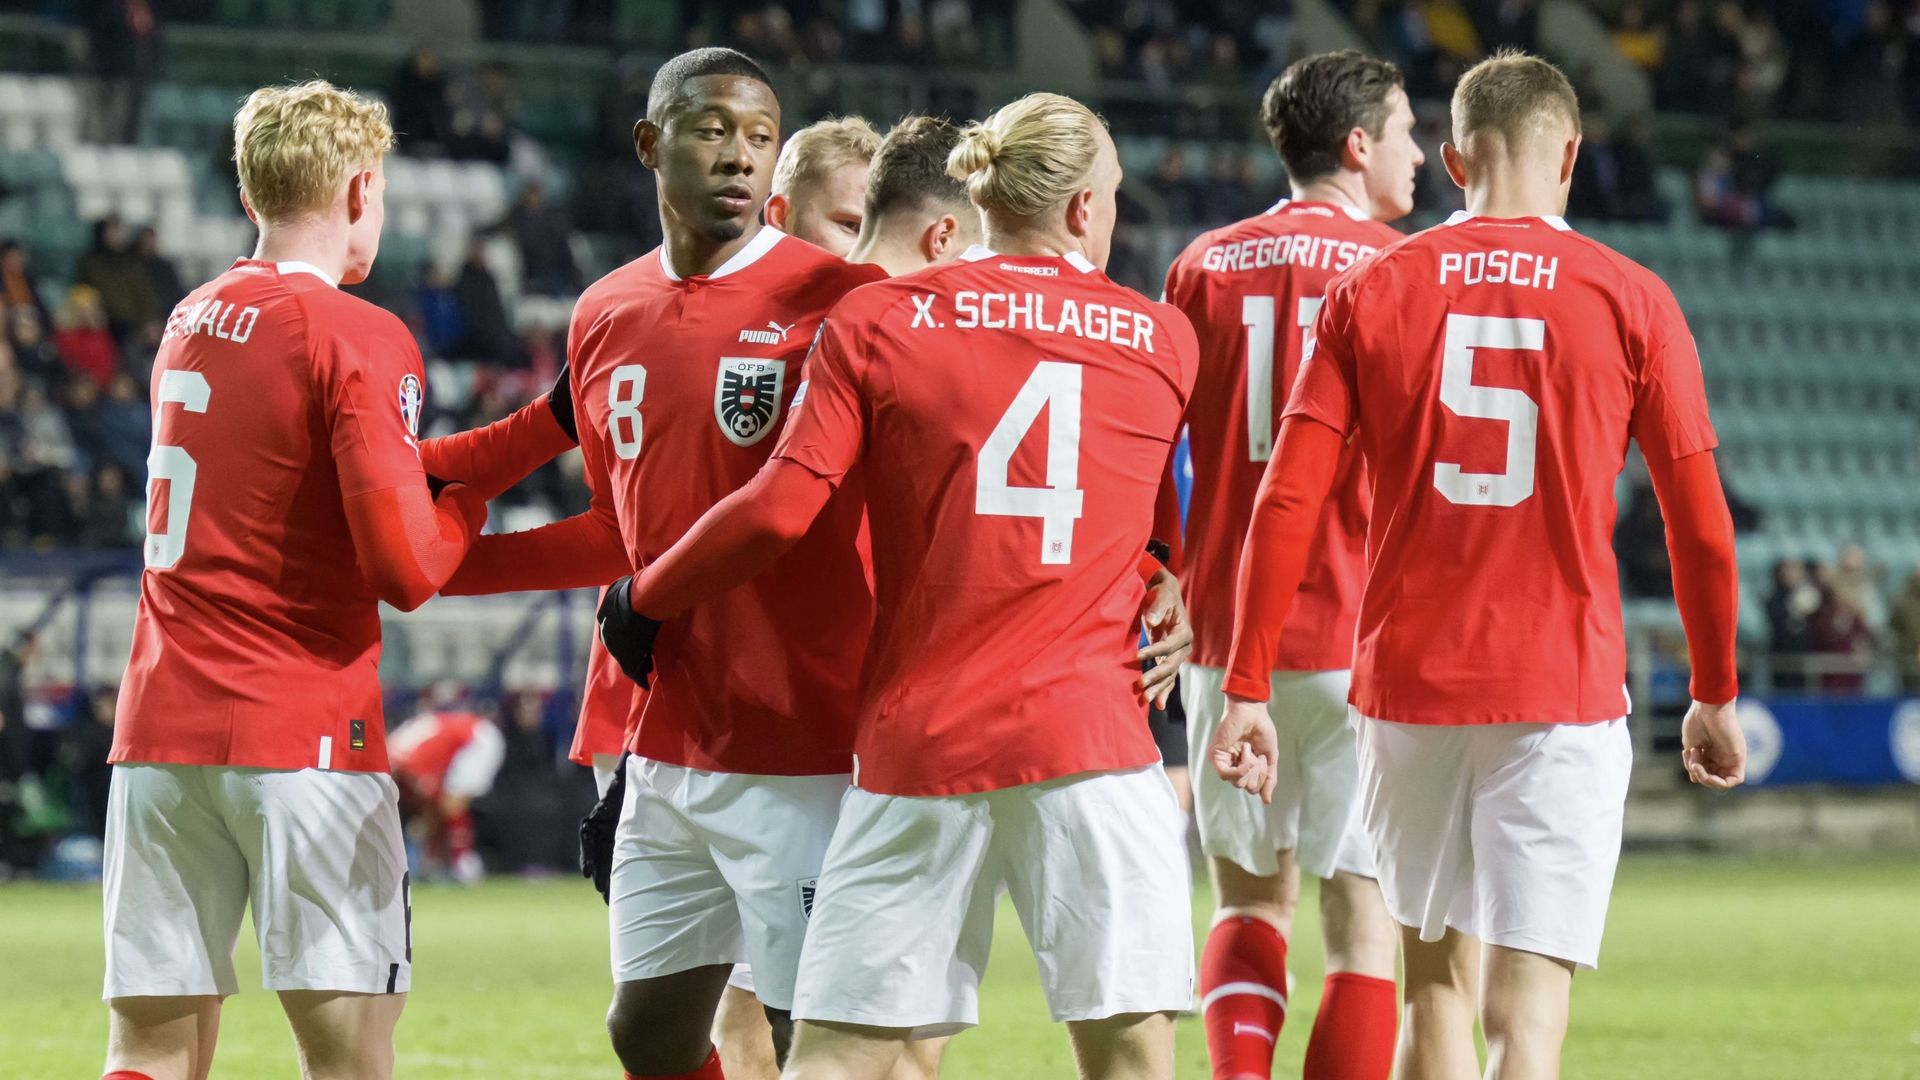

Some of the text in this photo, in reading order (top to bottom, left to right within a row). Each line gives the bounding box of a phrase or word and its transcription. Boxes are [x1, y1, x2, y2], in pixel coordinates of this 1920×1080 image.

[910, 291, 1155, 353] X. SCHLAGER
[1438, 250, 1558, 290] POSCH
[738, 329, 780, 345] PUMA
[1242, 295, 1325, 462] 1
[144, 369, 212, 568] 6
[608, 364, 647, 460] 8
[975, 360, 1084, 565] 4
[1433, 313, 1545, 508] 5
